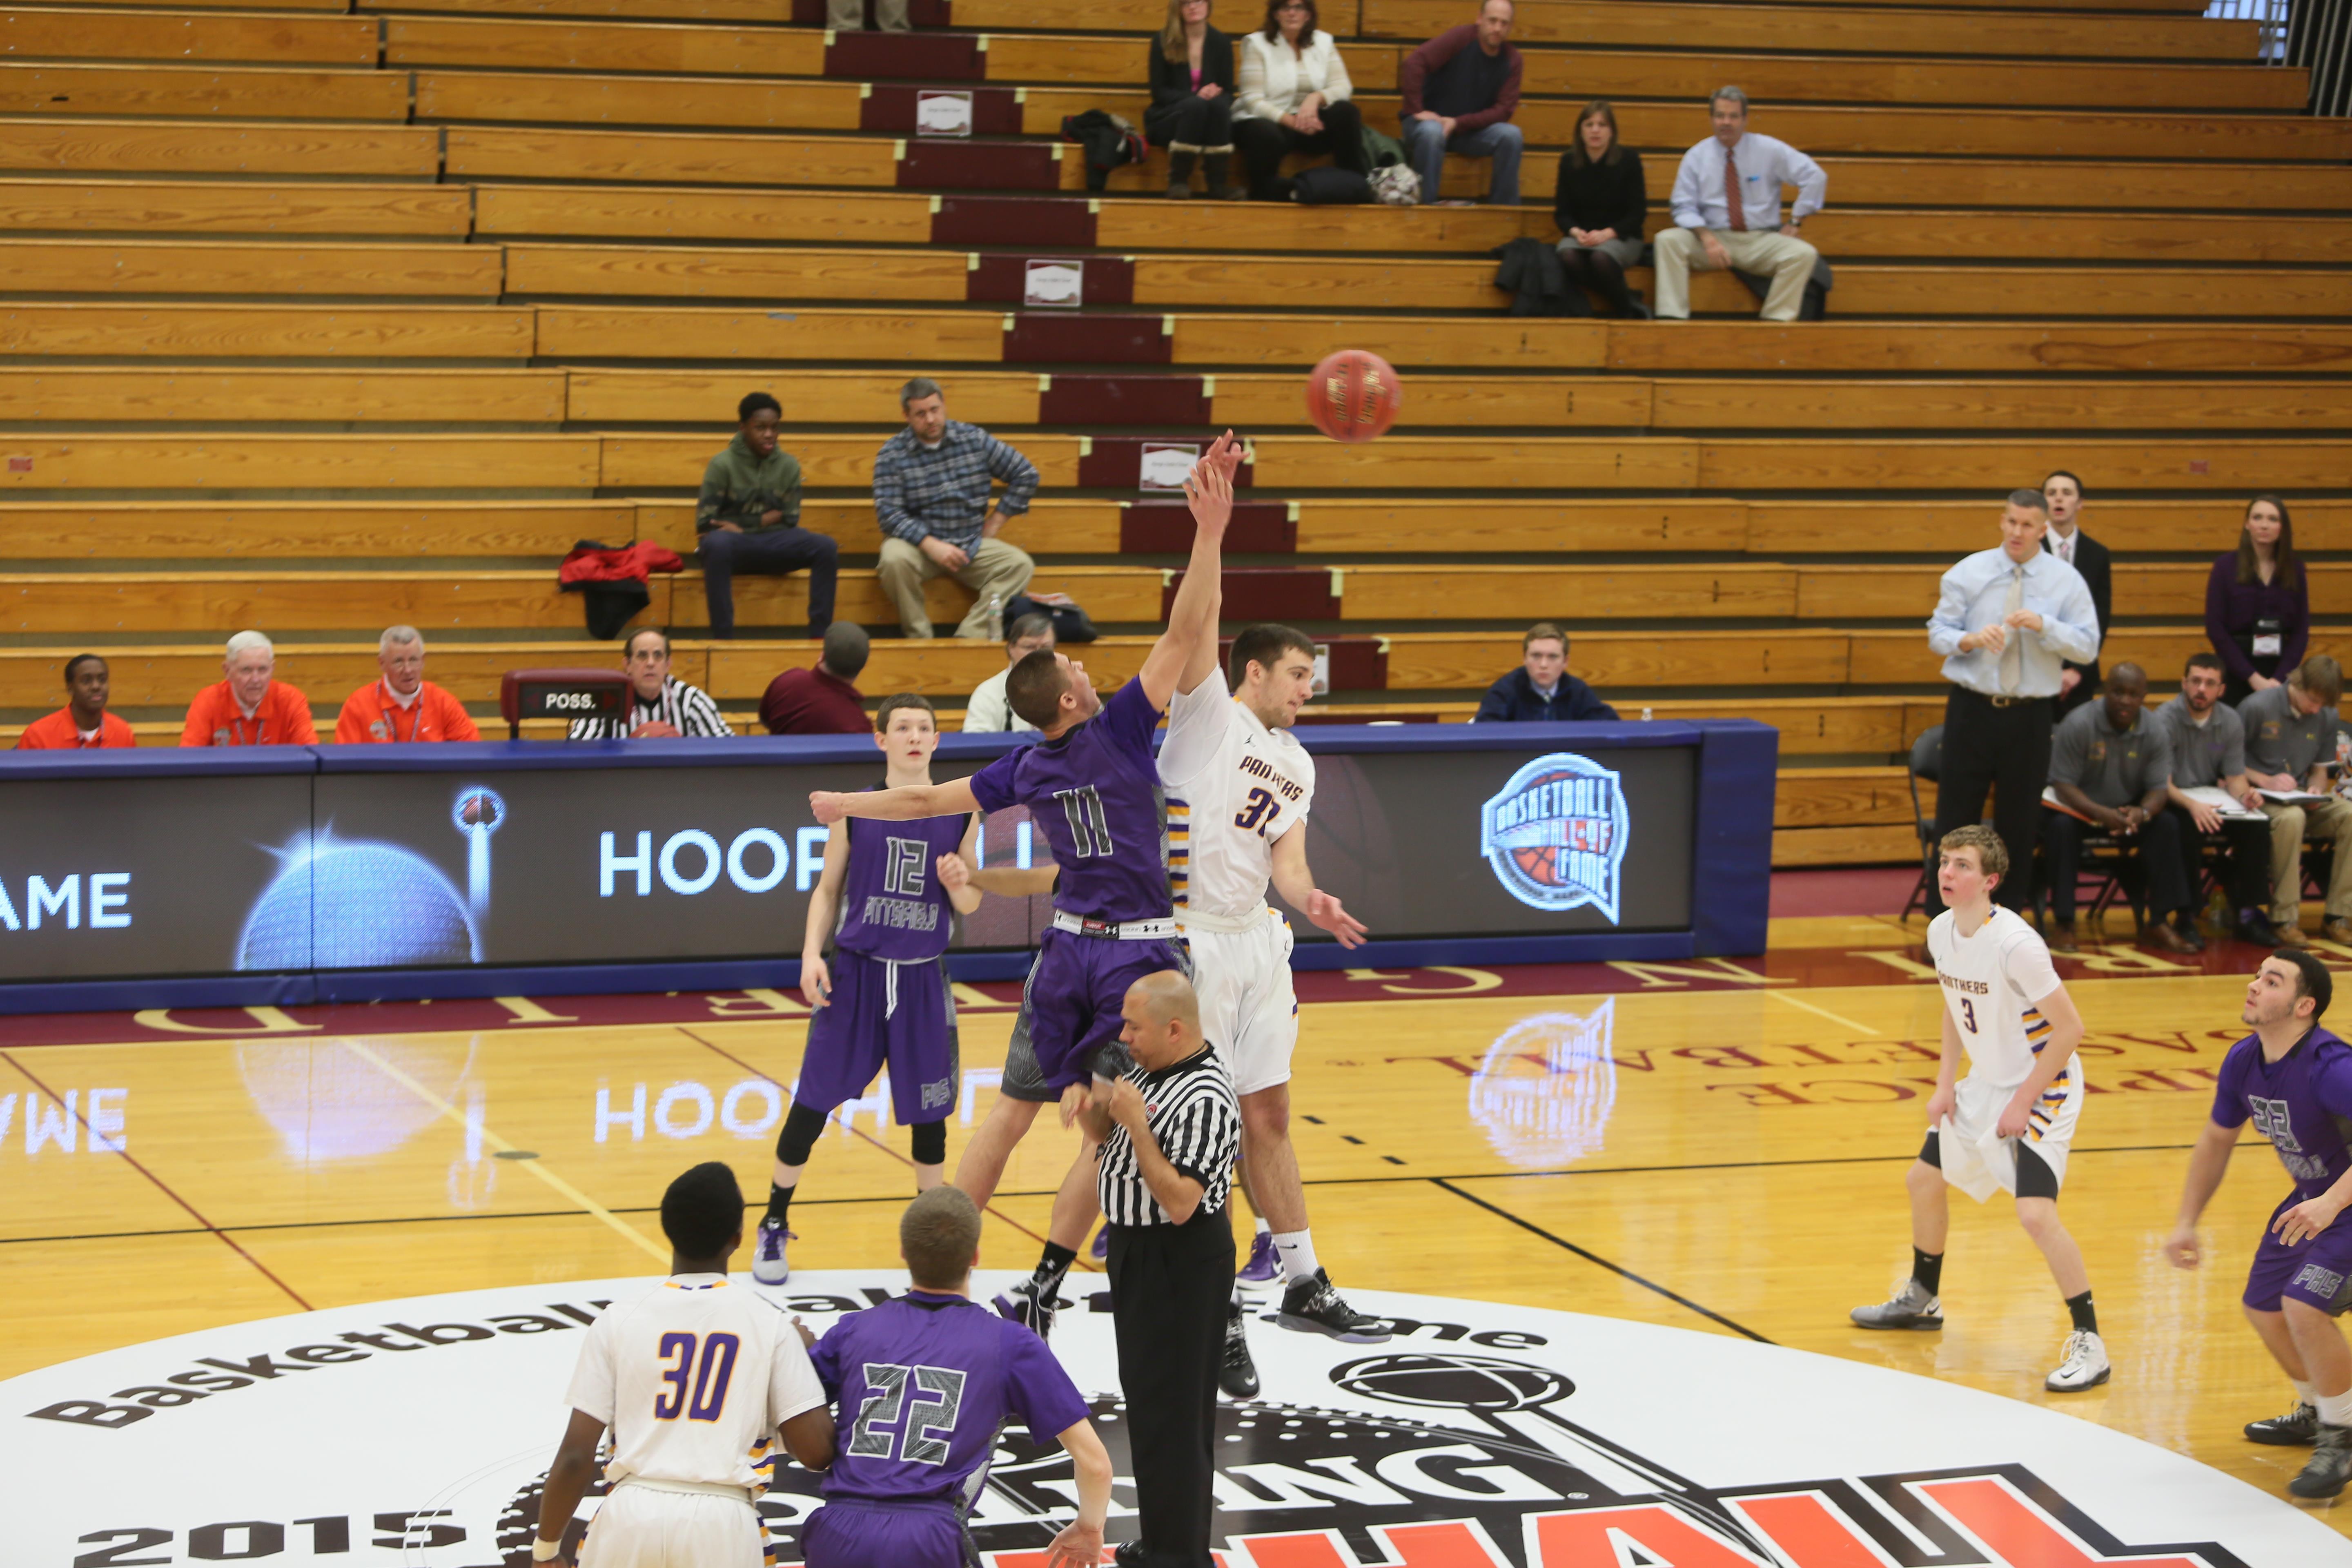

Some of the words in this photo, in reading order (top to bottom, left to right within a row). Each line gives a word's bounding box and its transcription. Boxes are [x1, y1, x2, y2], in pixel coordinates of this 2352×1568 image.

[546, 693, 597, 709] POSS.
[1052, 784, 1114, 858] 11
[884, 836, 929, 896] 12
[862, 895, 939, 931] PITTSFIELD
[1960, 998, 1979, 1034] 3
[2292, 1263, 2344, 1299] PHS
[654, 1331, 741, 1423] 30
[846, 1362, 968, 1466] 22
[74, 1509, 467, 1568] 2015
